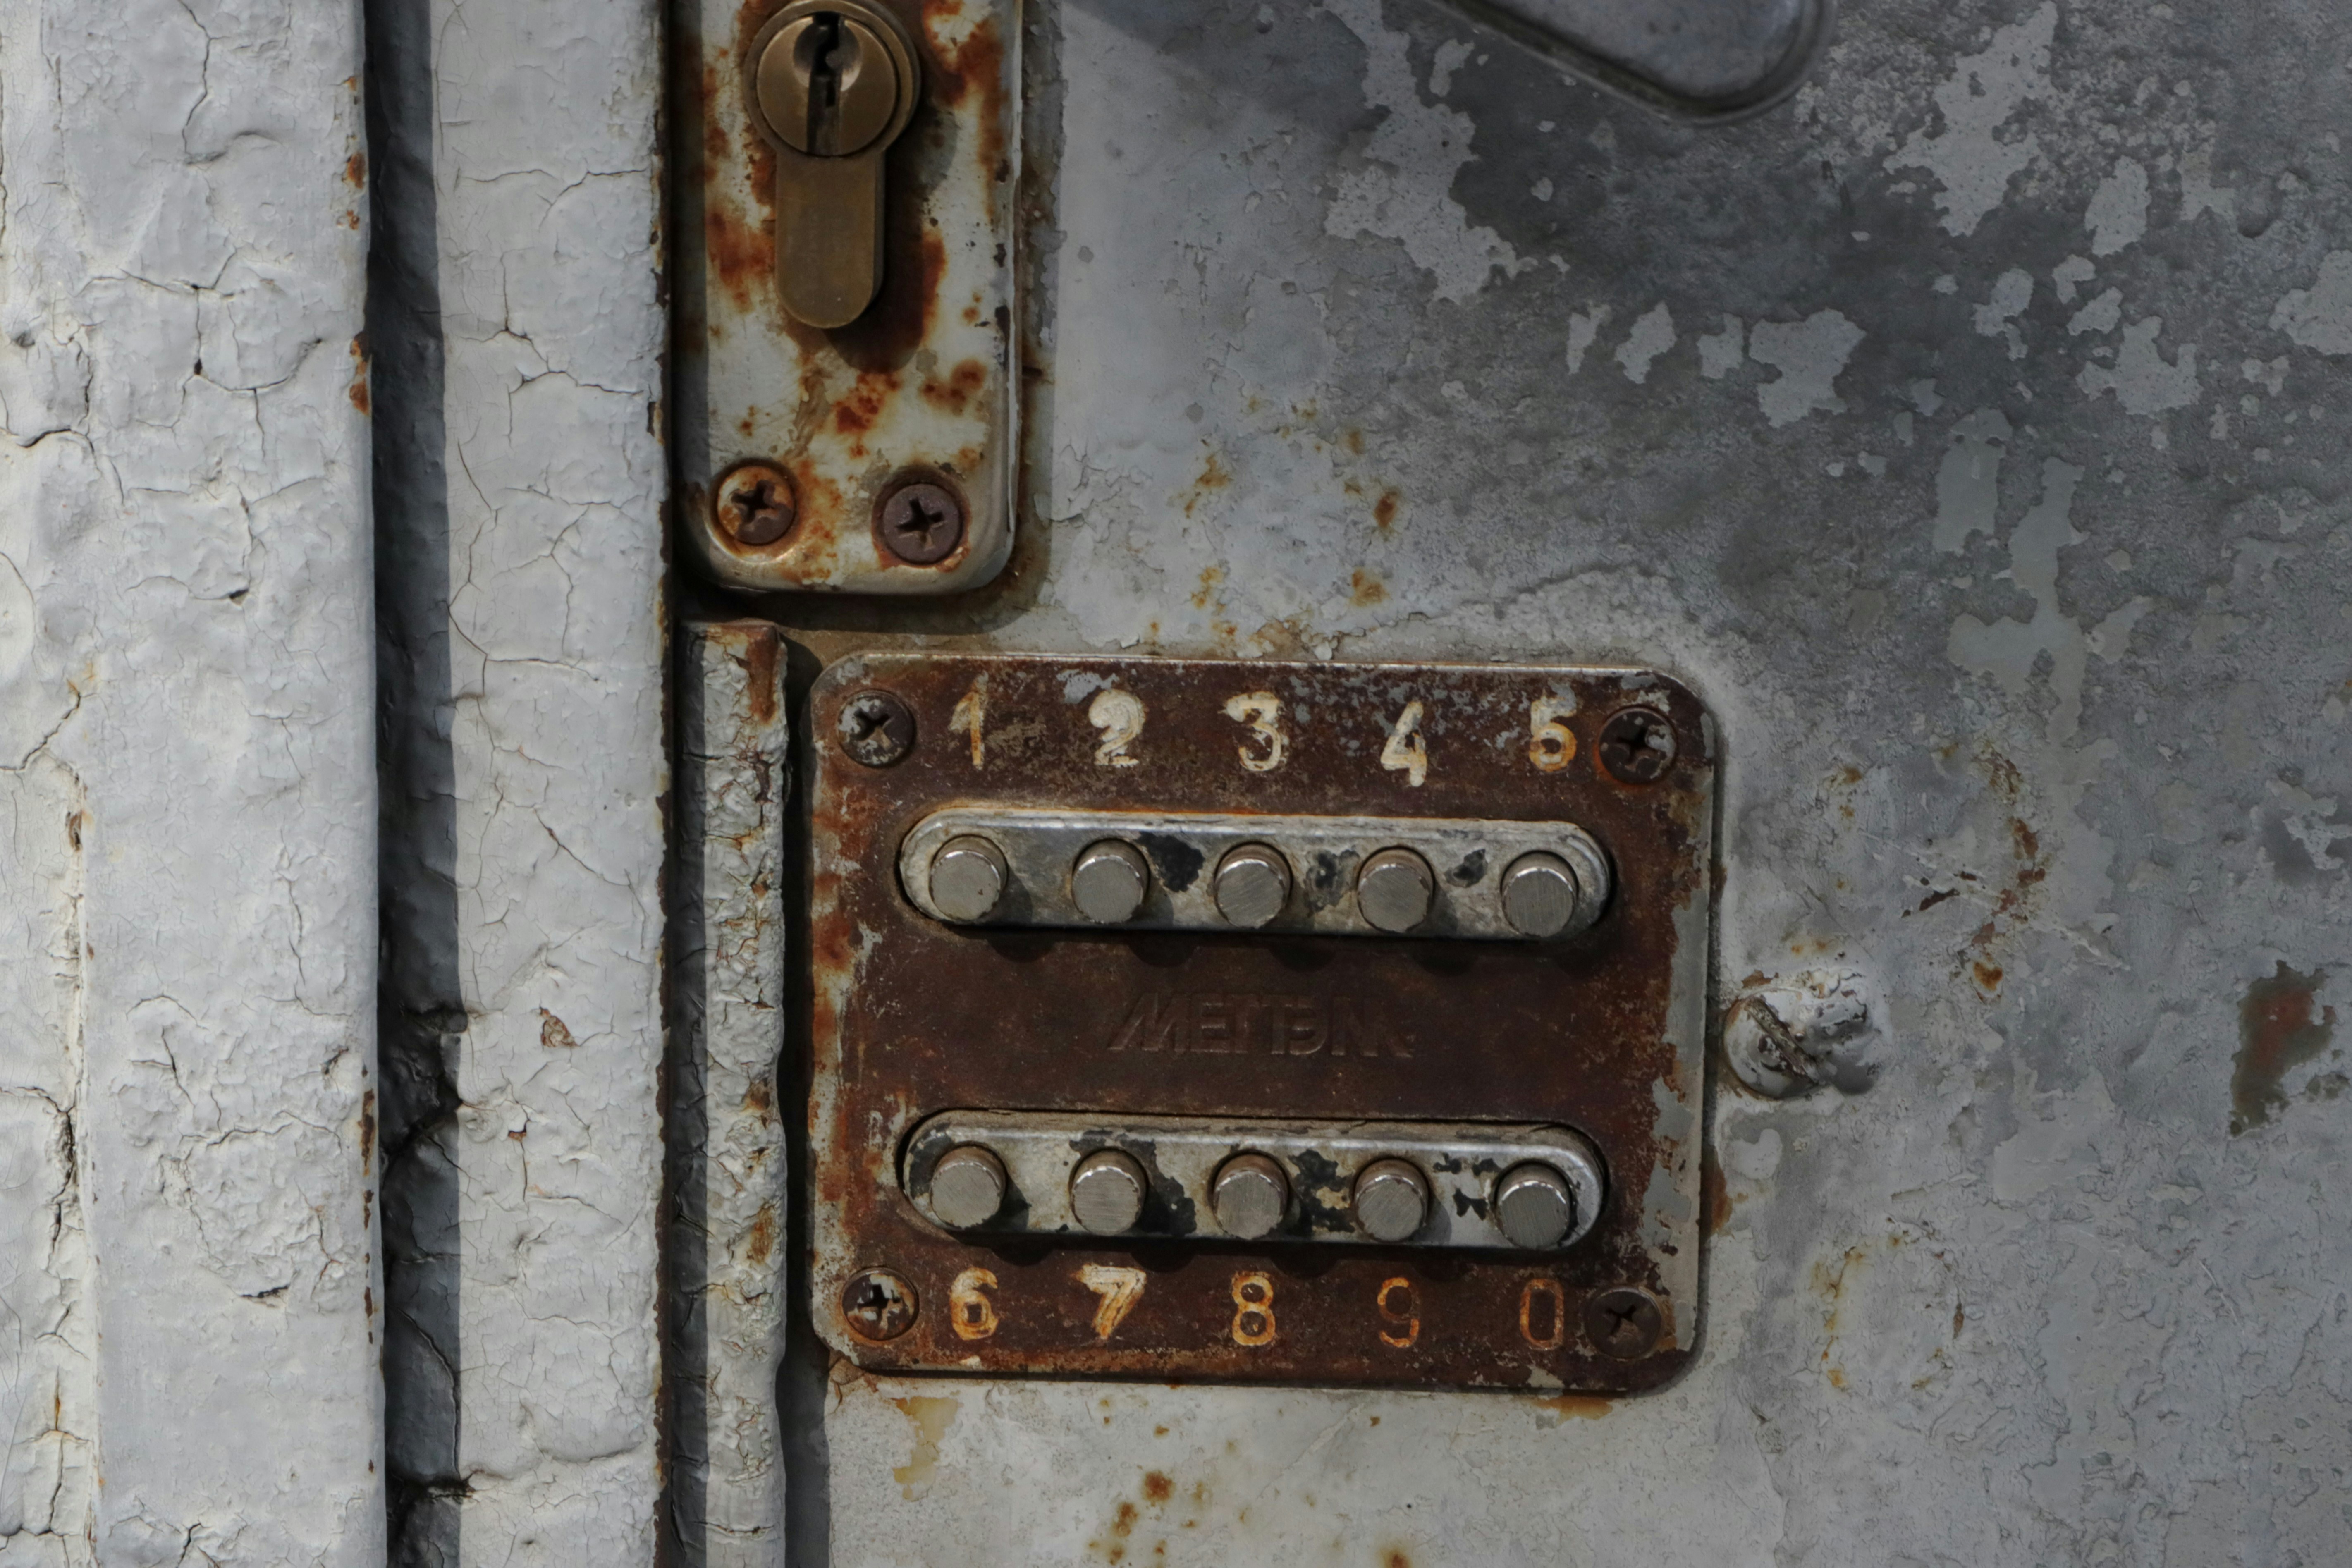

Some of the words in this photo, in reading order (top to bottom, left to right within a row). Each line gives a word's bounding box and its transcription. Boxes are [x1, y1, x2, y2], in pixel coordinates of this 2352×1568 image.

[948, 671, 987, 770] 1
[1089, 688, 1145, 767] 2
[1224, 691, 1288, 772] 3
[1380, 700, 1427, 787] 4
[1529, 680, 1578, 772] 5
[950, 1267, 999, 1341] 6
[1071, 1264, 1147, 1341] 7
[1231, 1271, 1276, 1346] 8
[1377, 1277, 1420, 1348] 9
[1520, 1279, 1564, 1350] 0
